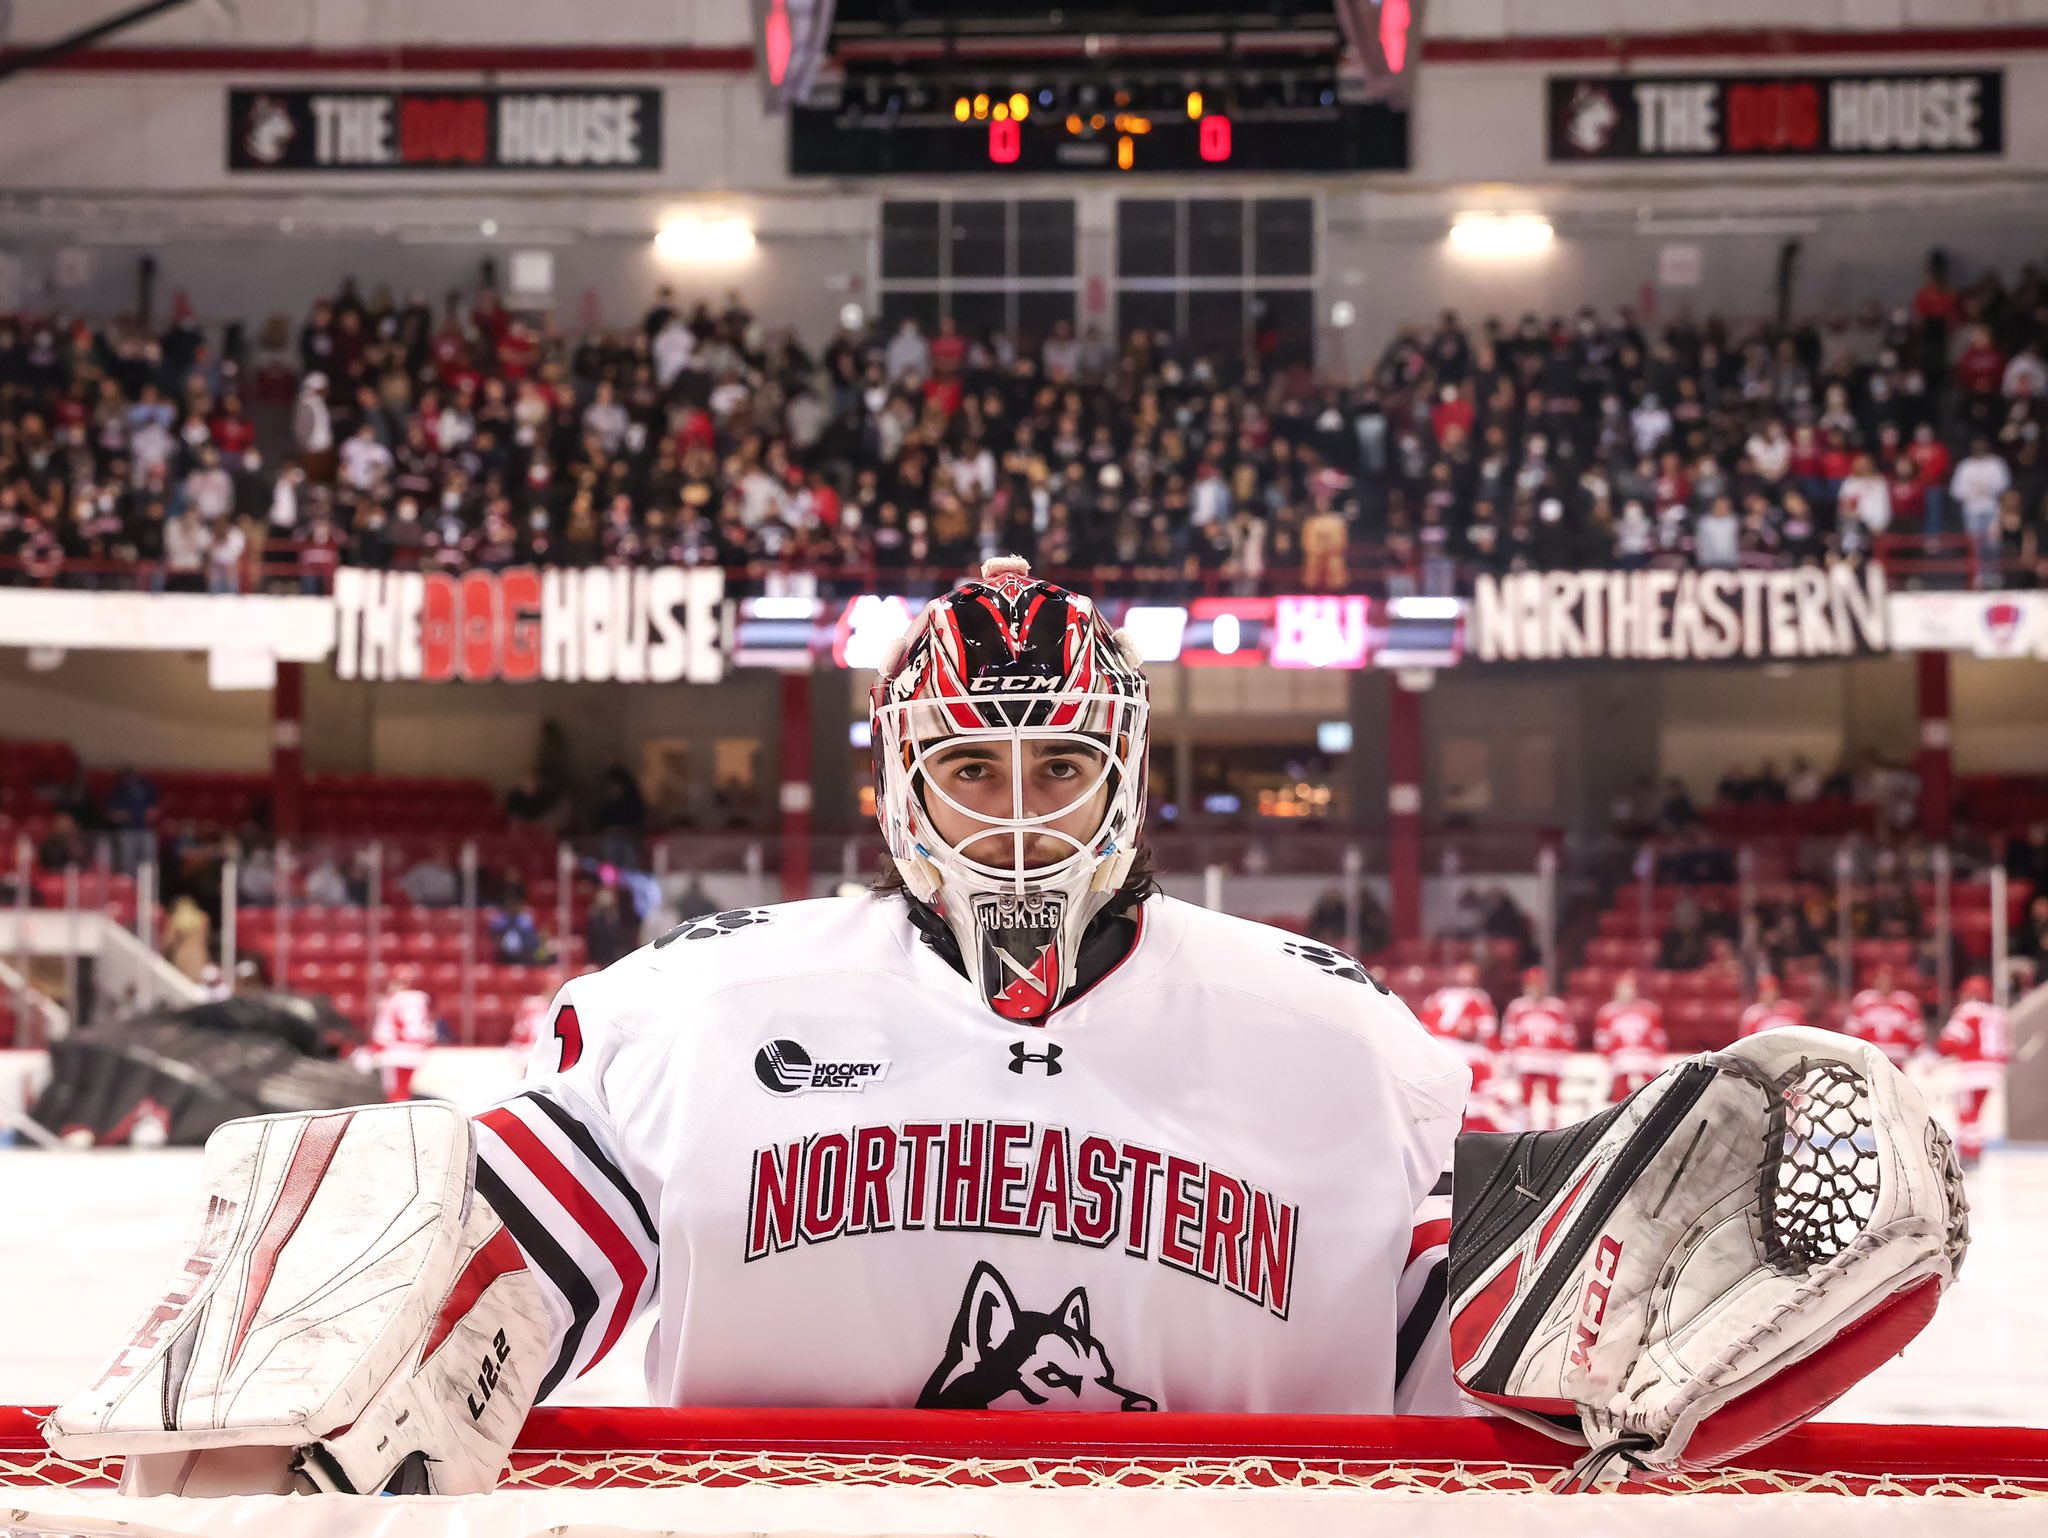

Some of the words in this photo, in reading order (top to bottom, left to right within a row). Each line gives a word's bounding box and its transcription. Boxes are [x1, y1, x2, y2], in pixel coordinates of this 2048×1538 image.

[311, 95, 393, 164] THE
[499, 95, 641, 164] HOUSE
[1634, 82, 1721, 152] THE
[1829, 77, 1982, 150] HOUSE
[334, 566, 425, 682] THE
[422, 567, 542, 684] DOG
[541, 566, 725, 684] HOUSE
[1474, 563, 1888, 662] NORTHEASTERN
[969, 675, 1062, 692] CCM
[979, 904, 1059, 931] HUSKIES
[991, 943, 1052, 1000] N
[811, 1076, 854, 1088] EAST
[814, 1063, 881, 1076] HOCKEY
[745, 1118, 1299, 1322] NORTHEASTERN
[1570, 1234, 1624, 1374] CCM
[467, 1327, 511, 1421] L12.2
